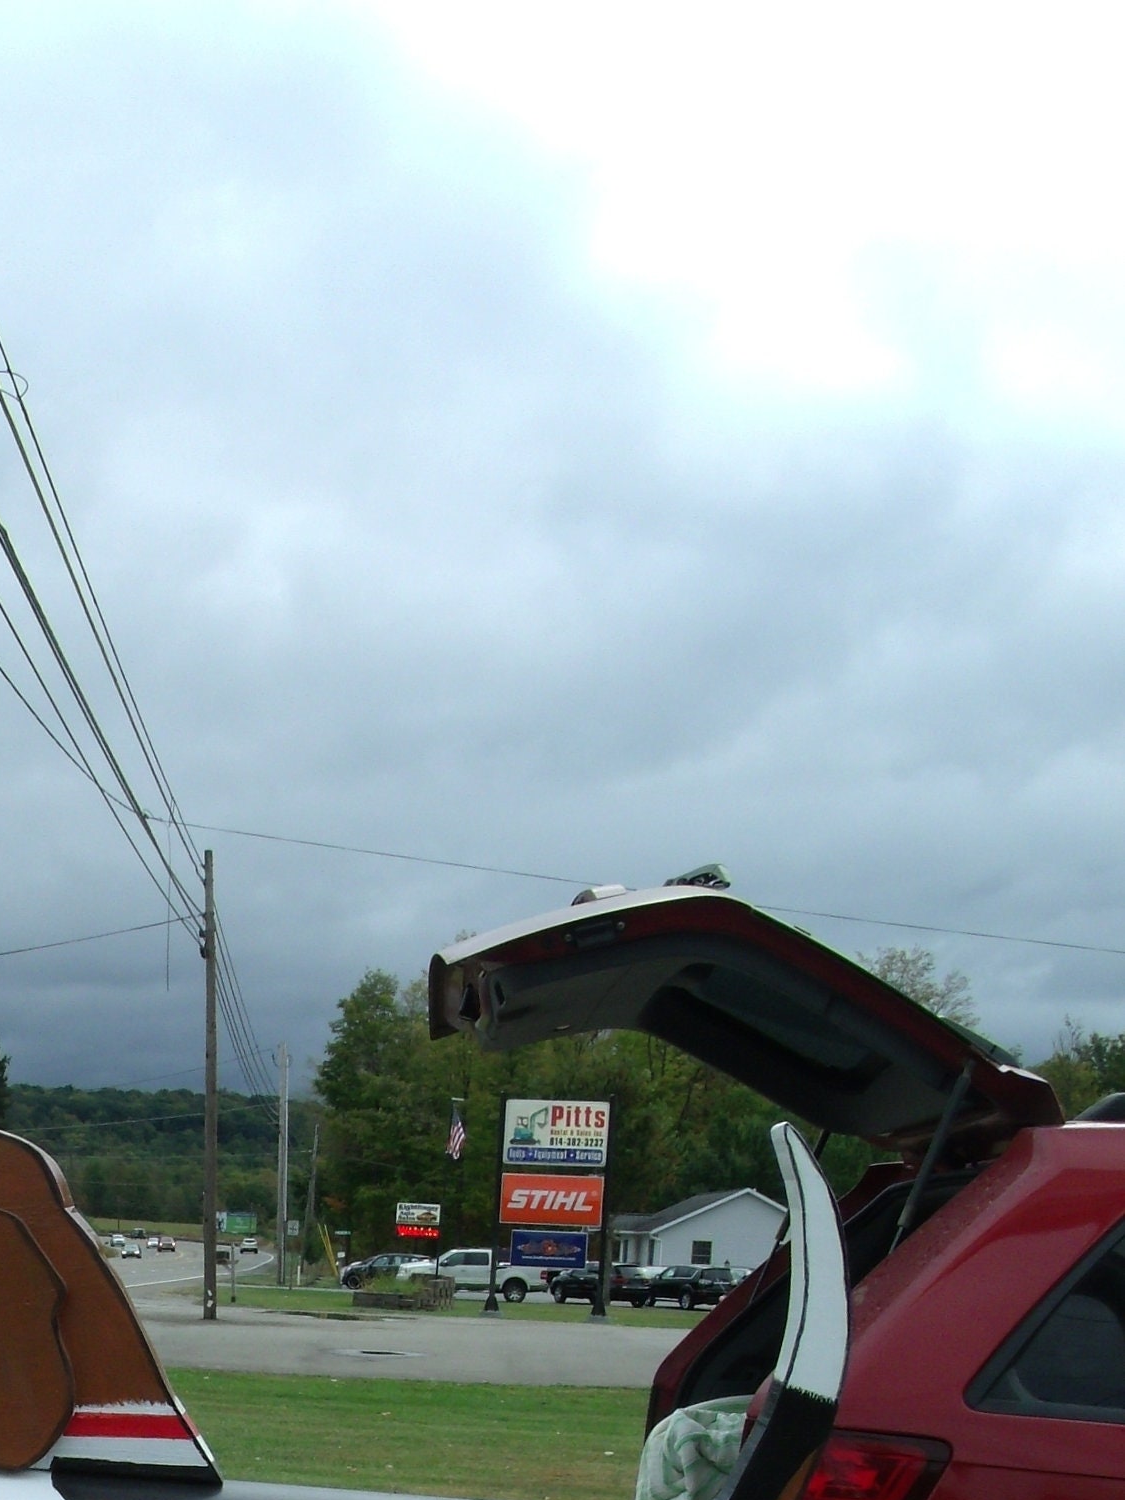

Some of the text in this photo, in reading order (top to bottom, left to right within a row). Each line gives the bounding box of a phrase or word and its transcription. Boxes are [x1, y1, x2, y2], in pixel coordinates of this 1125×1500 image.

[550, 1105, 606, 1128] Pitts
[575, 1151, 603, 1161] Service
[507, 1188, 594, 1212] STIHL
